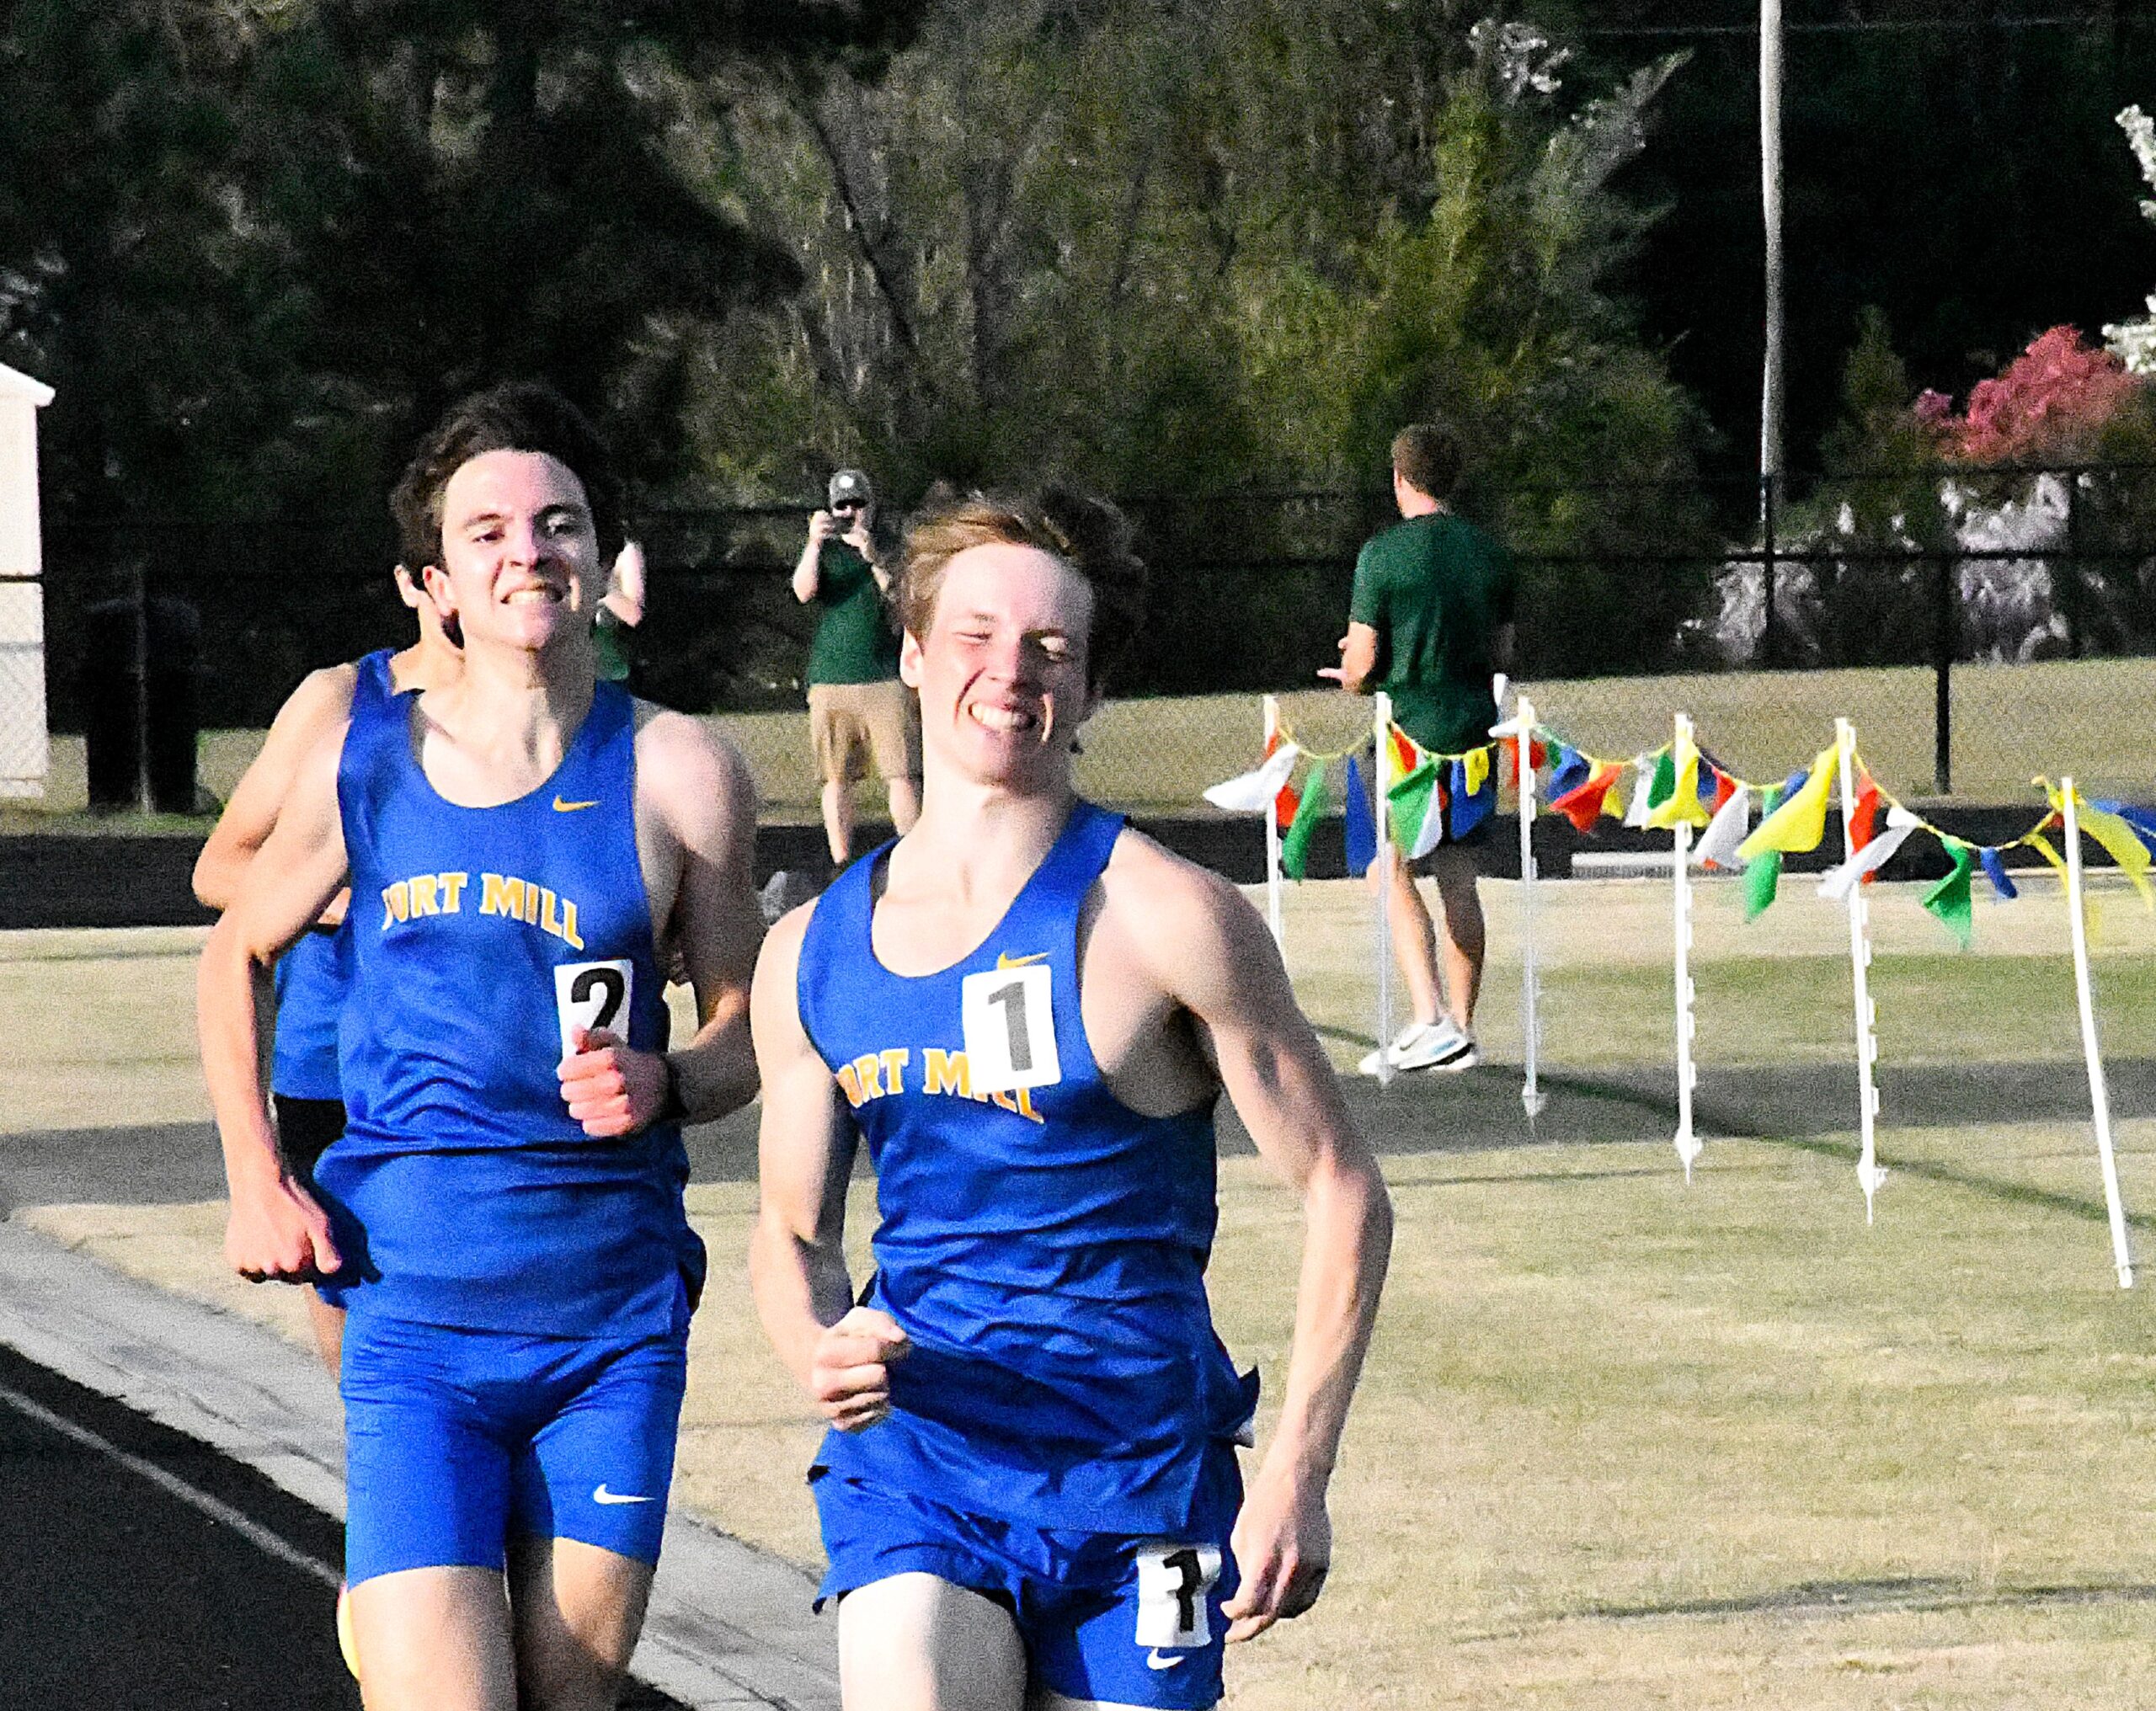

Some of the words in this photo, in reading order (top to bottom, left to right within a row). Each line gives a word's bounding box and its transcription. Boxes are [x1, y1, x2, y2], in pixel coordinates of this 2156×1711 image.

[478, 872, 584, 951] MILL
[570, 967, 626, 1031] 2
[988, 980, 1033, 1073] 1
[834, 1047, 910, 1109] ORT
[1162, 1548, 1203, 1633] 1
